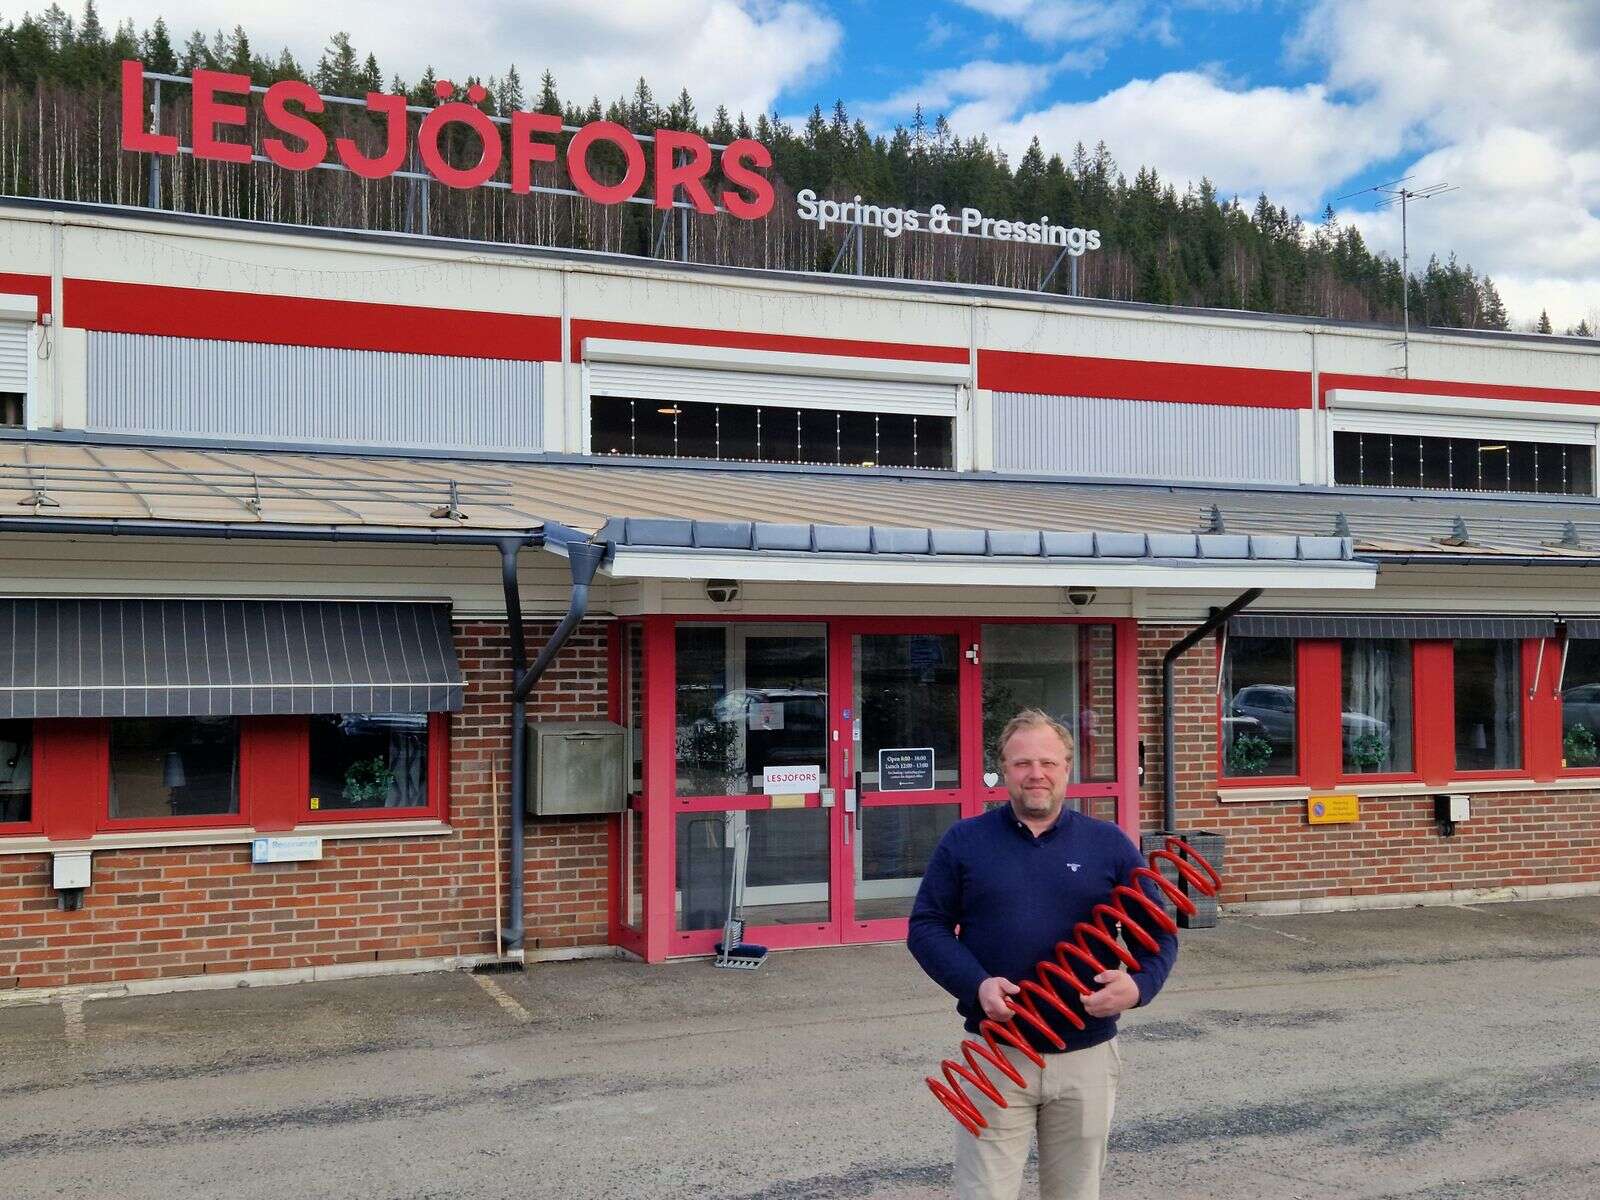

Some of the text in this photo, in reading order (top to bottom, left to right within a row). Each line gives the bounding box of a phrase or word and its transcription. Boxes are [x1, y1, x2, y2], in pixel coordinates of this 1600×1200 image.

[121, 60, 776, 221] LESJÖFORS
[797, 188, 1101, 256] Springs & Pressings
